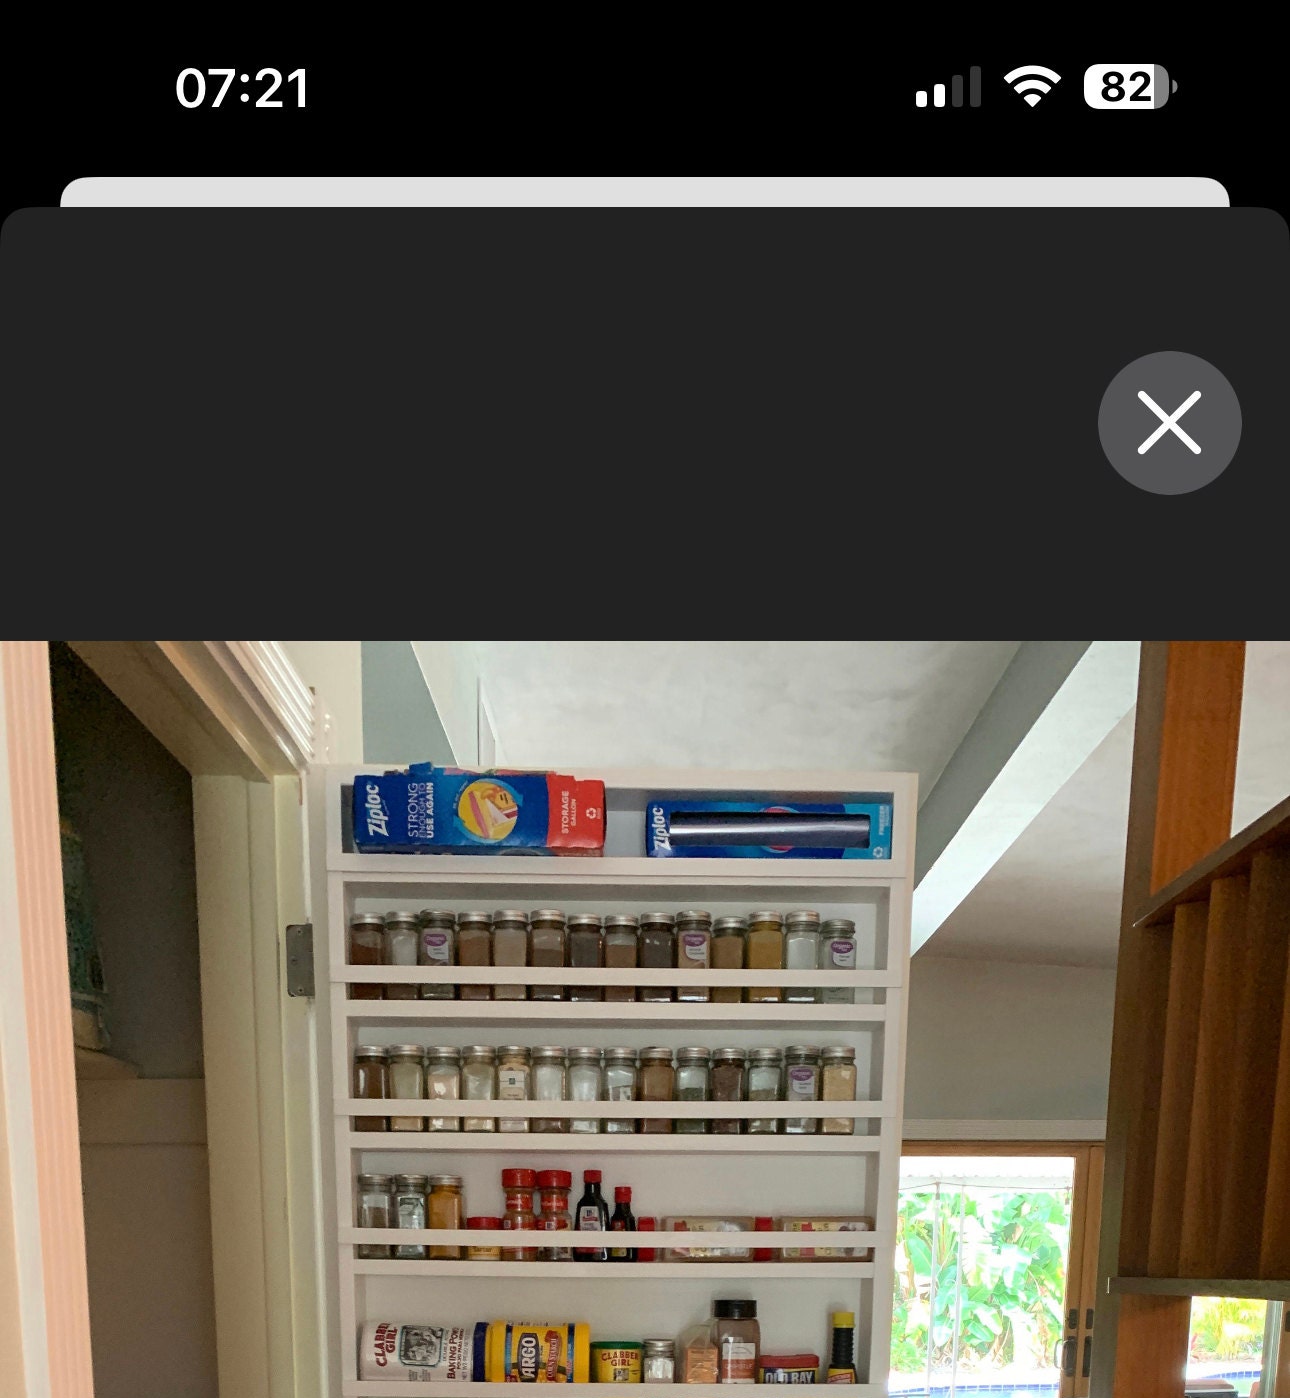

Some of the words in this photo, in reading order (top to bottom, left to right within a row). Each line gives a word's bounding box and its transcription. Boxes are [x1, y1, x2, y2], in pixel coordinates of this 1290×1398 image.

[418, 783, 426, 795] TO
[426, 782, 434, 815] AGAIN
[365, 784, 389, 837] Ziploc
[408, 783, 419, 838] STRONG
[418, 796, 426, 838] ENOUGH
[426, 816, 434, 838] USE
[561, 790, 570, 834] STORAGE
[654, 807, 672, 851] Ziploc
[385, 1328, 398, 1354] GIRL
[521, 1337, 537, 1378] ARGO
[601, 1350, 639, 1361] CLABBER
[447, 1346, 457, 1380] BAKING
[610, 1358, 631, 1367] GIRL
[766, 1372, 789, 1384] OLD
[792, 1371, 813, 1384] BAY
